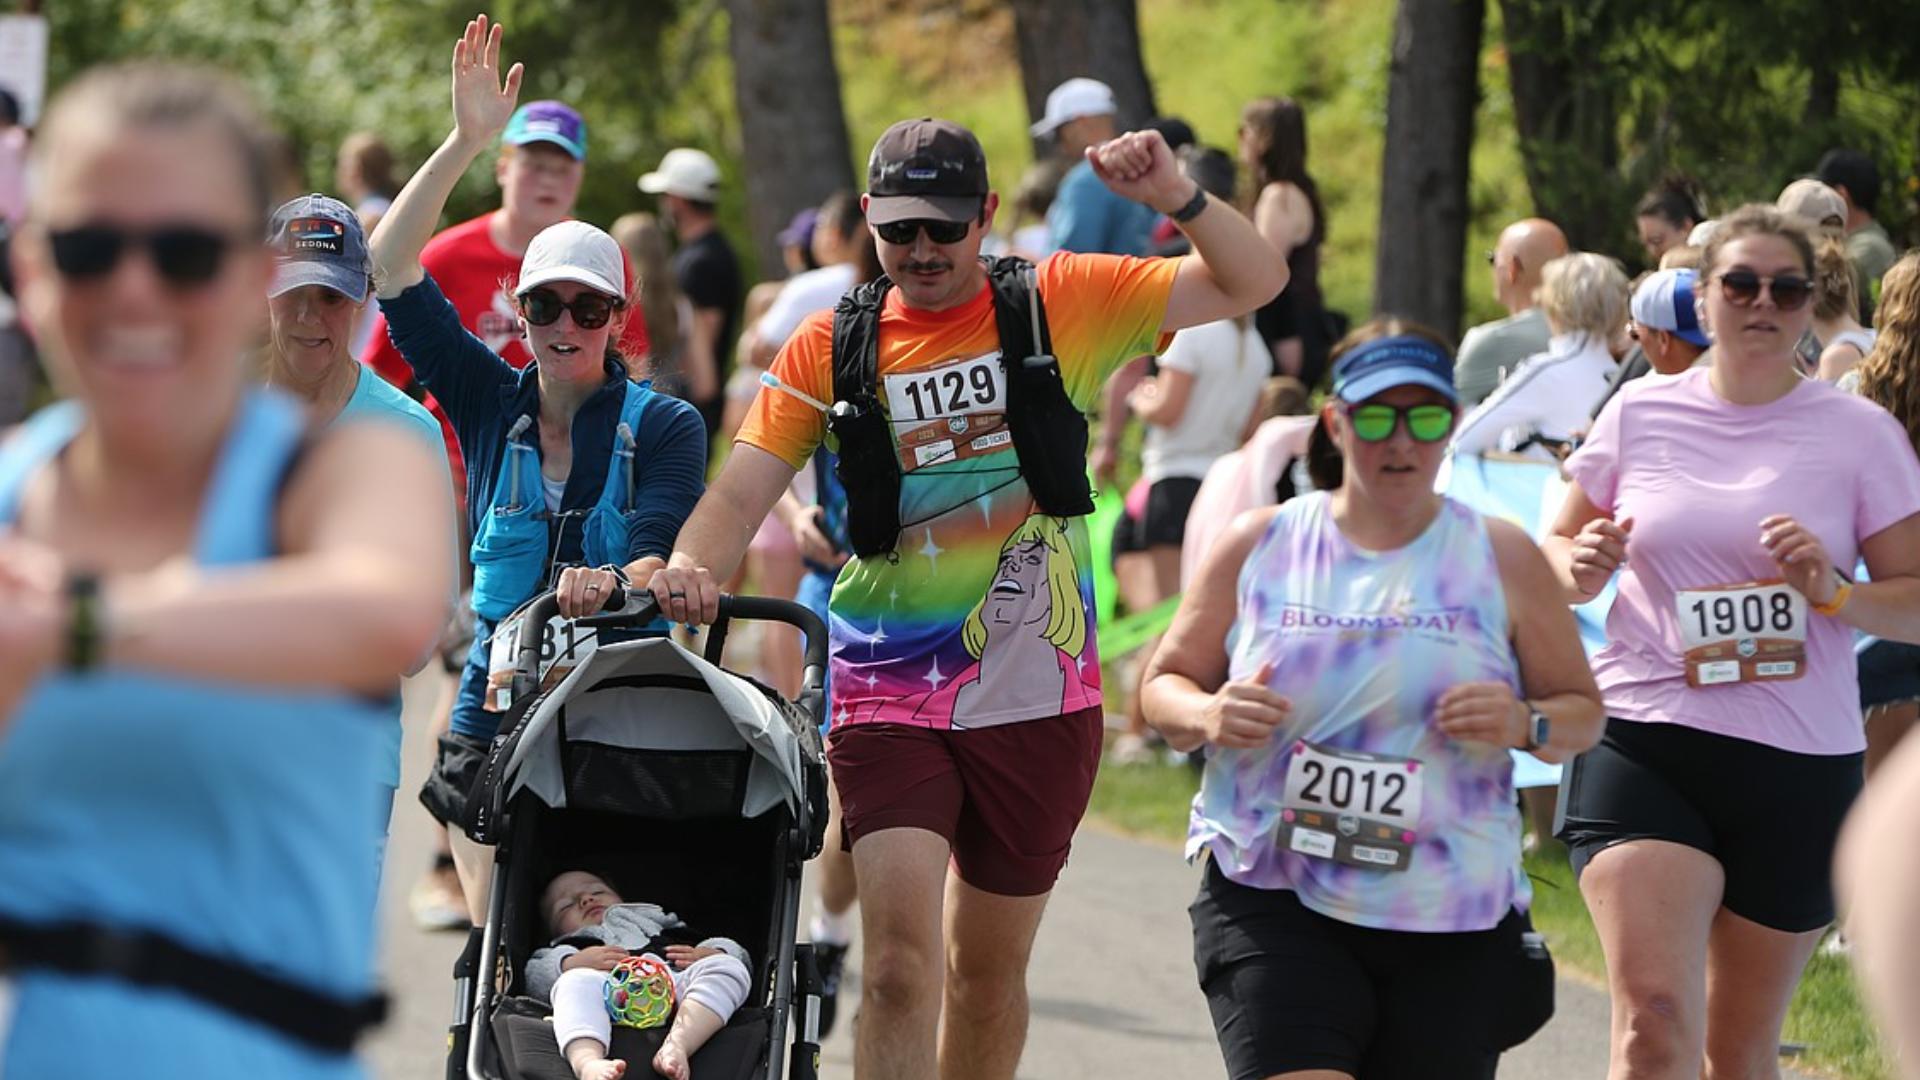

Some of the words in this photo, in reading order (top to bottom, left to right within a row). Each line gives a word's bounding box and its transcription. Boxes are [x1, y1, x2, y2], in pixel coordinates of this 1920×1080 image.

[296, 240, 336, 250] SEDONA
[905, 365, 996, 420] 1129
[1281, 609, 1461, 633] BLOOMSDAY
[1692, 592, 1793, 637] 1908
[1300, 760, 1405, 816] 2012
